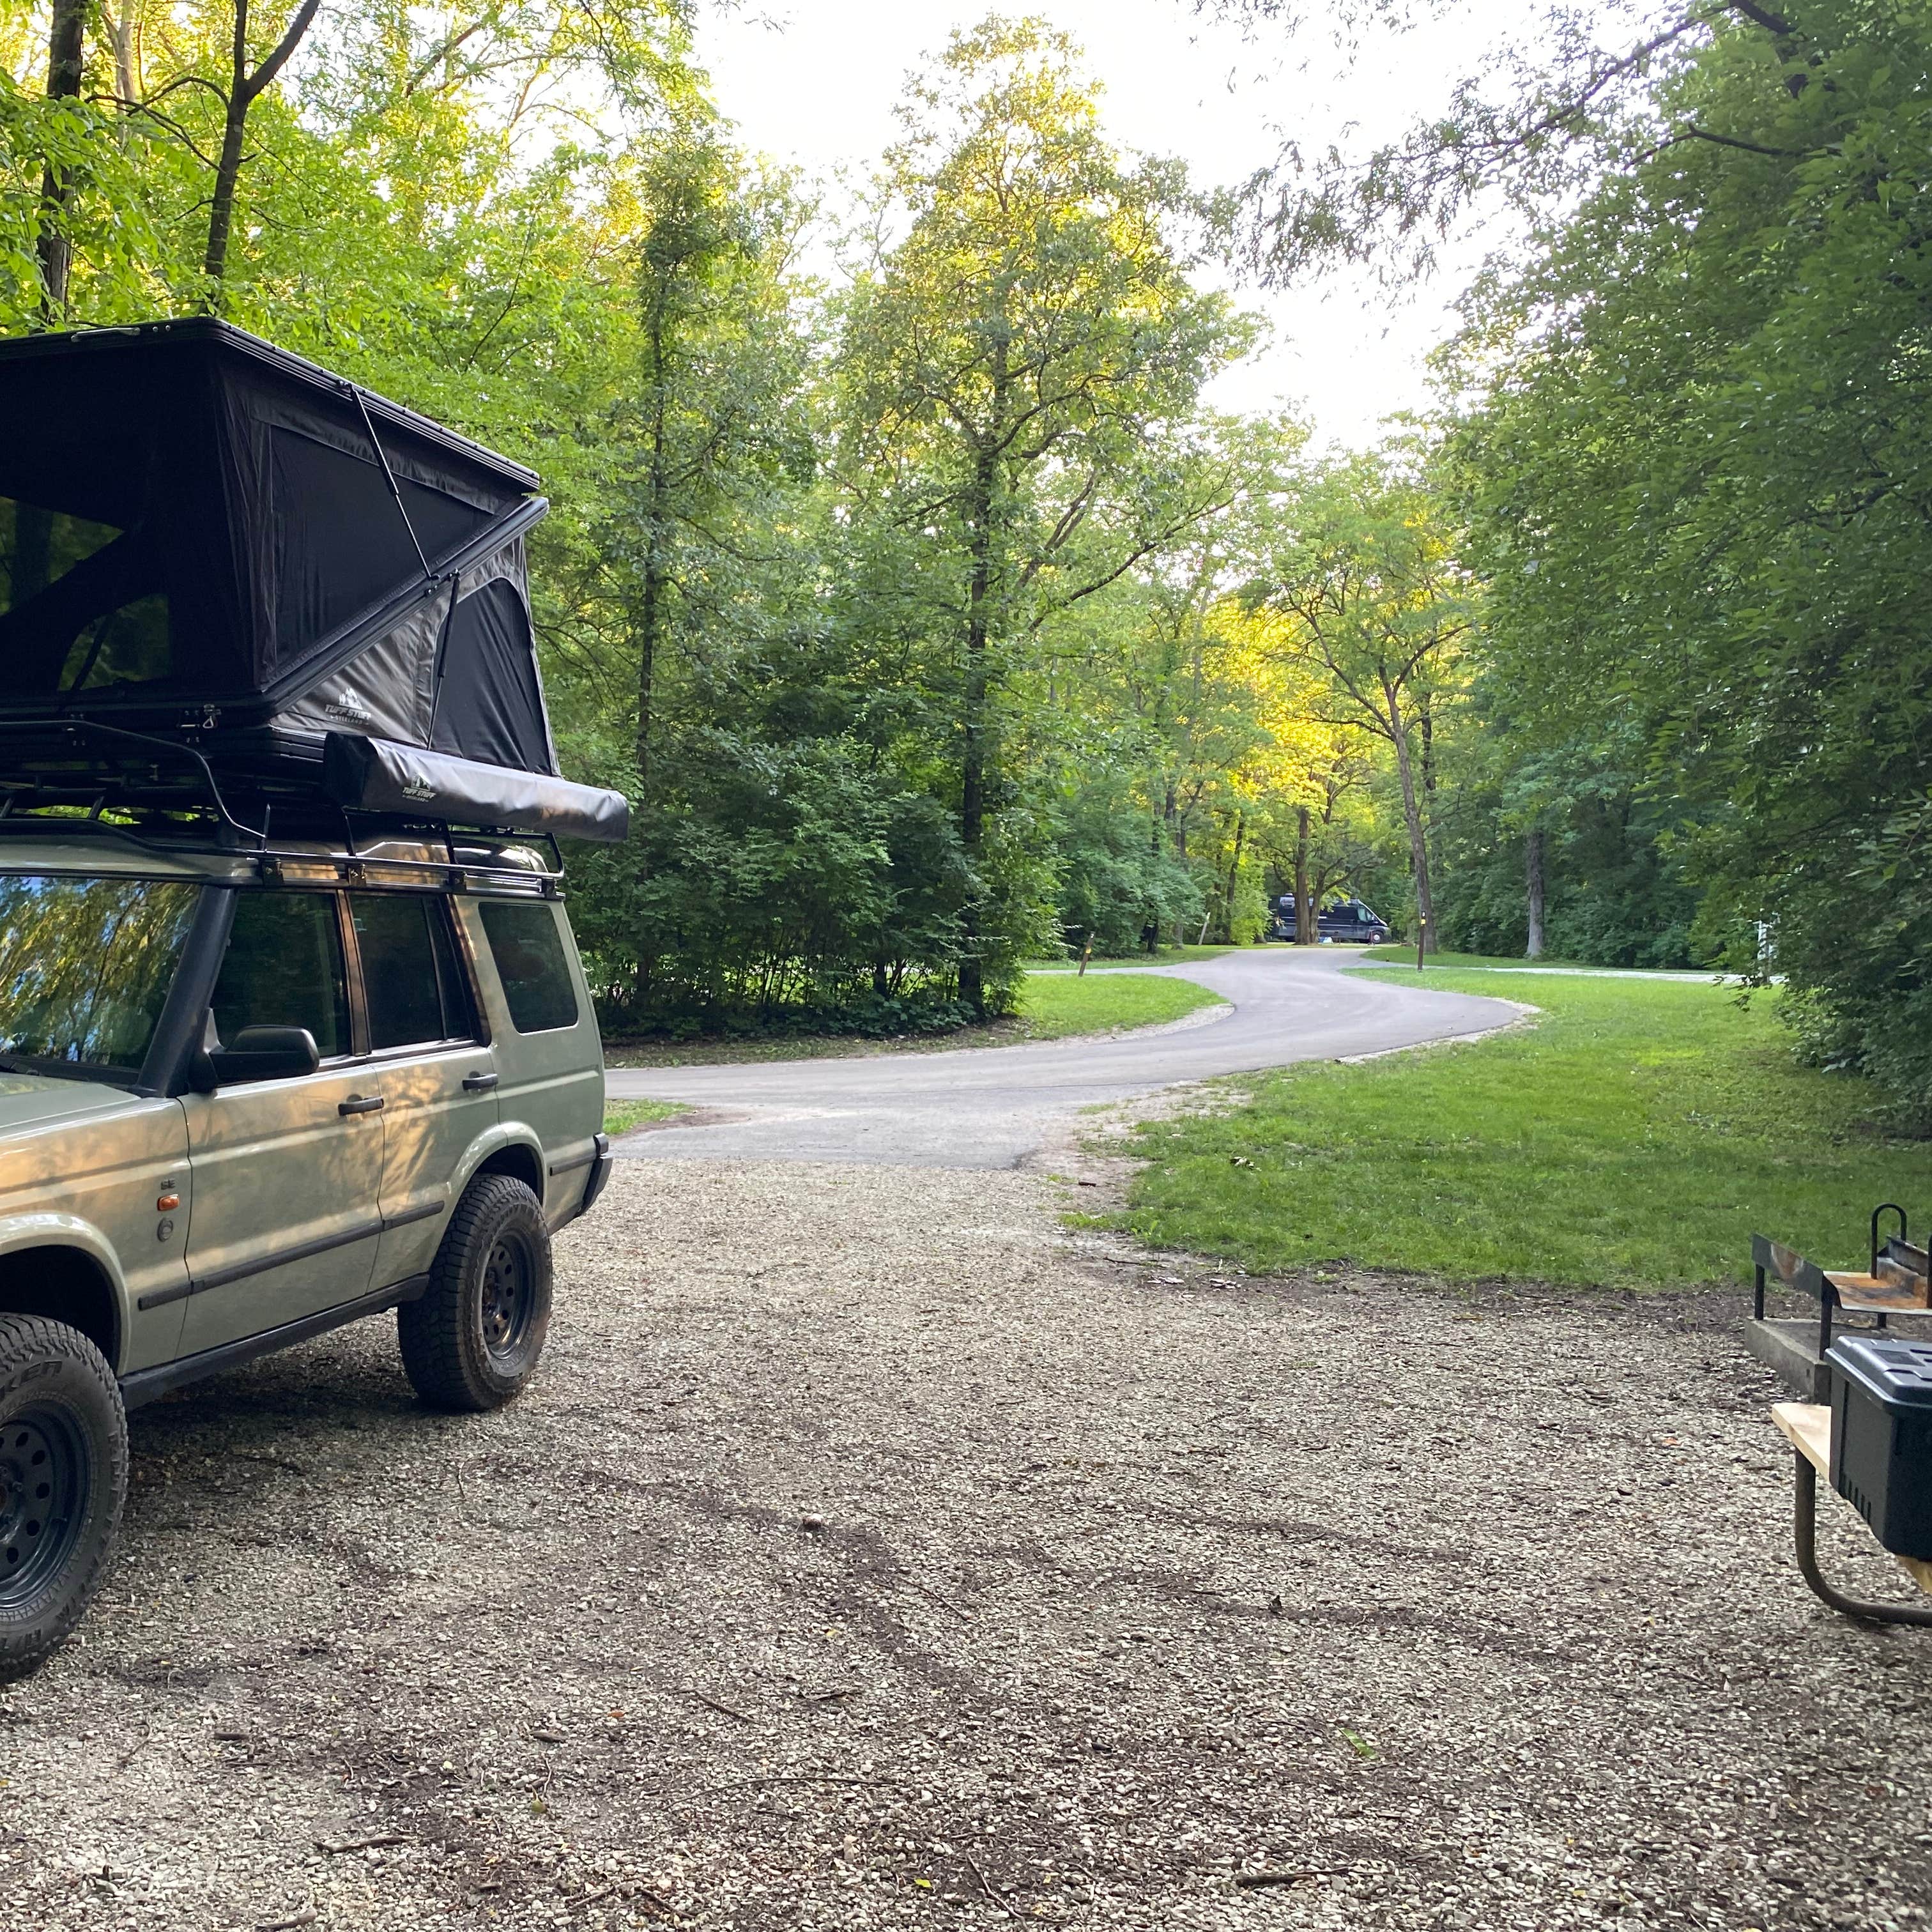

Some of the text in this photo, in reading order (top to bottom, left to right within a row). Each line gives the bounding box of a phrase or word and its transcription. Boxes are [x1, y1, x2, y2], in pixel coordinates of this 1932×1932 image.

[325, 704, 371, 720] TUFF STUFF
[402, 786, 436, 799] TUFF STUFF
